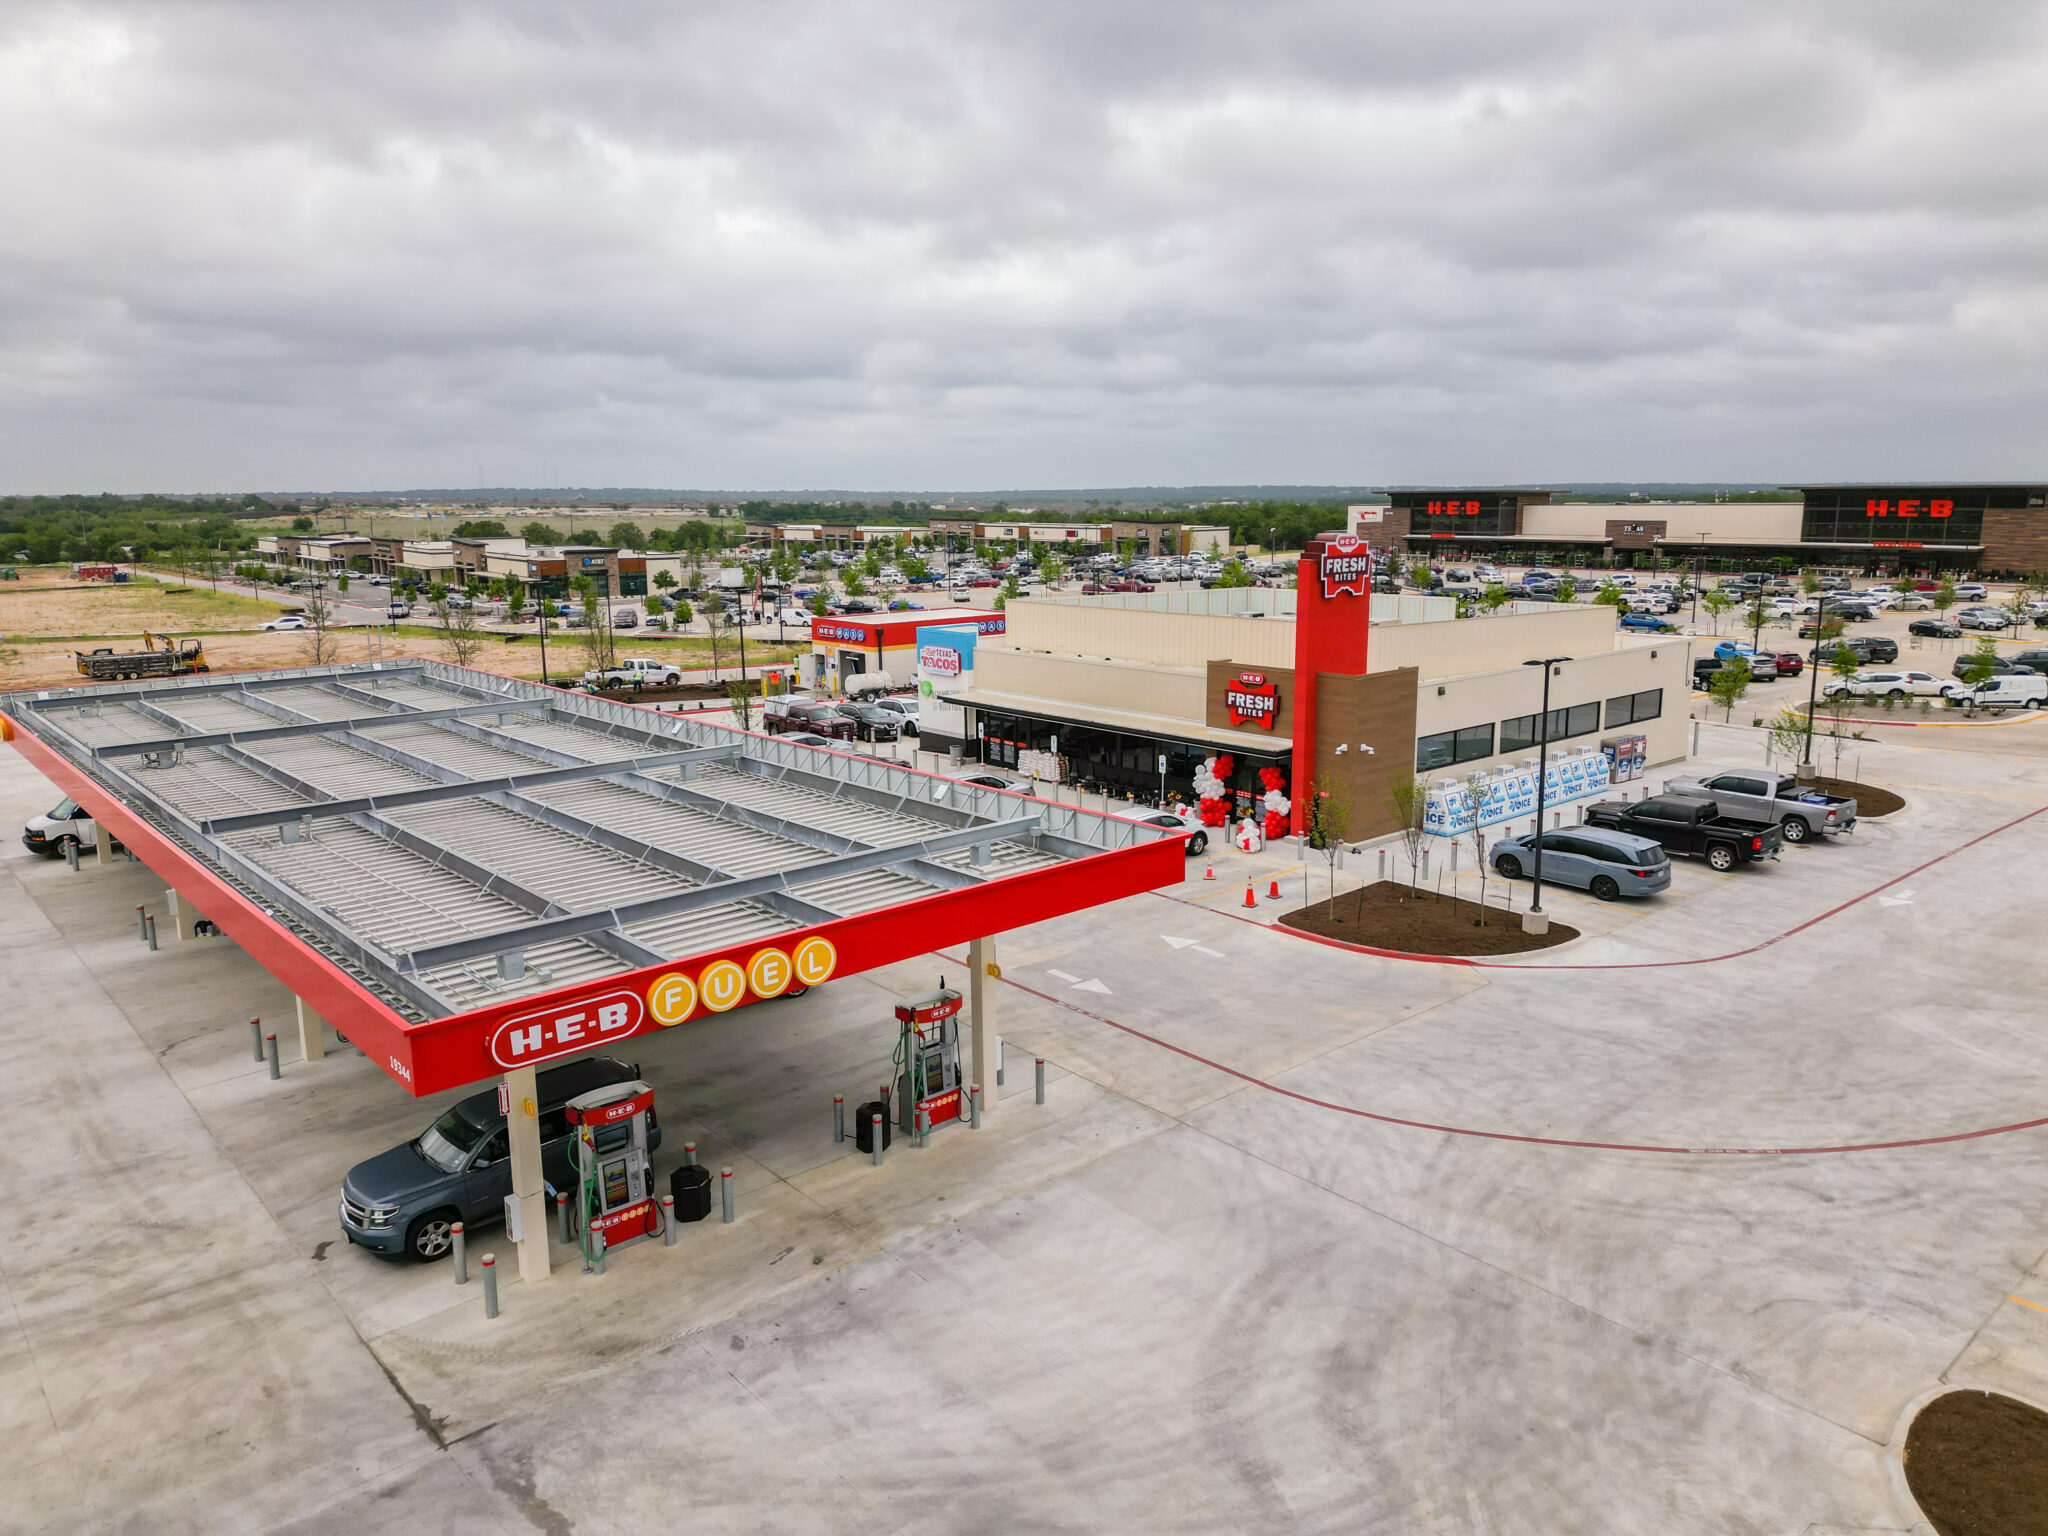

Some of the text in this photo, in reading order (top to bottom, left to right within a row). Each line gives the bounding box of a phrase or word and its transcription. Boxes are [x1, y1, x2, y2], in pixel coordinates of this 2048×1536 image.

[1326, 557, 1367, 574] FRESH
[1335, 573, 1357, 582] BITES
[980, 622, 1004, 631] WAS
[936, 649, 952, 658] TEXAS
[921, 656, 957, 671] TACOS
[1228, 692, 1274, 711] FRESH
[1238, 707, 1263, 717] BITES
[1521, 797, 1531, 808] ICE
[1493, 805, 1504, 816] ICE
[1425, 812, 1445, 825] ICE
[665, 951, 824, 1013] FUEL
[389, 1055, 411, 1083] 19344
